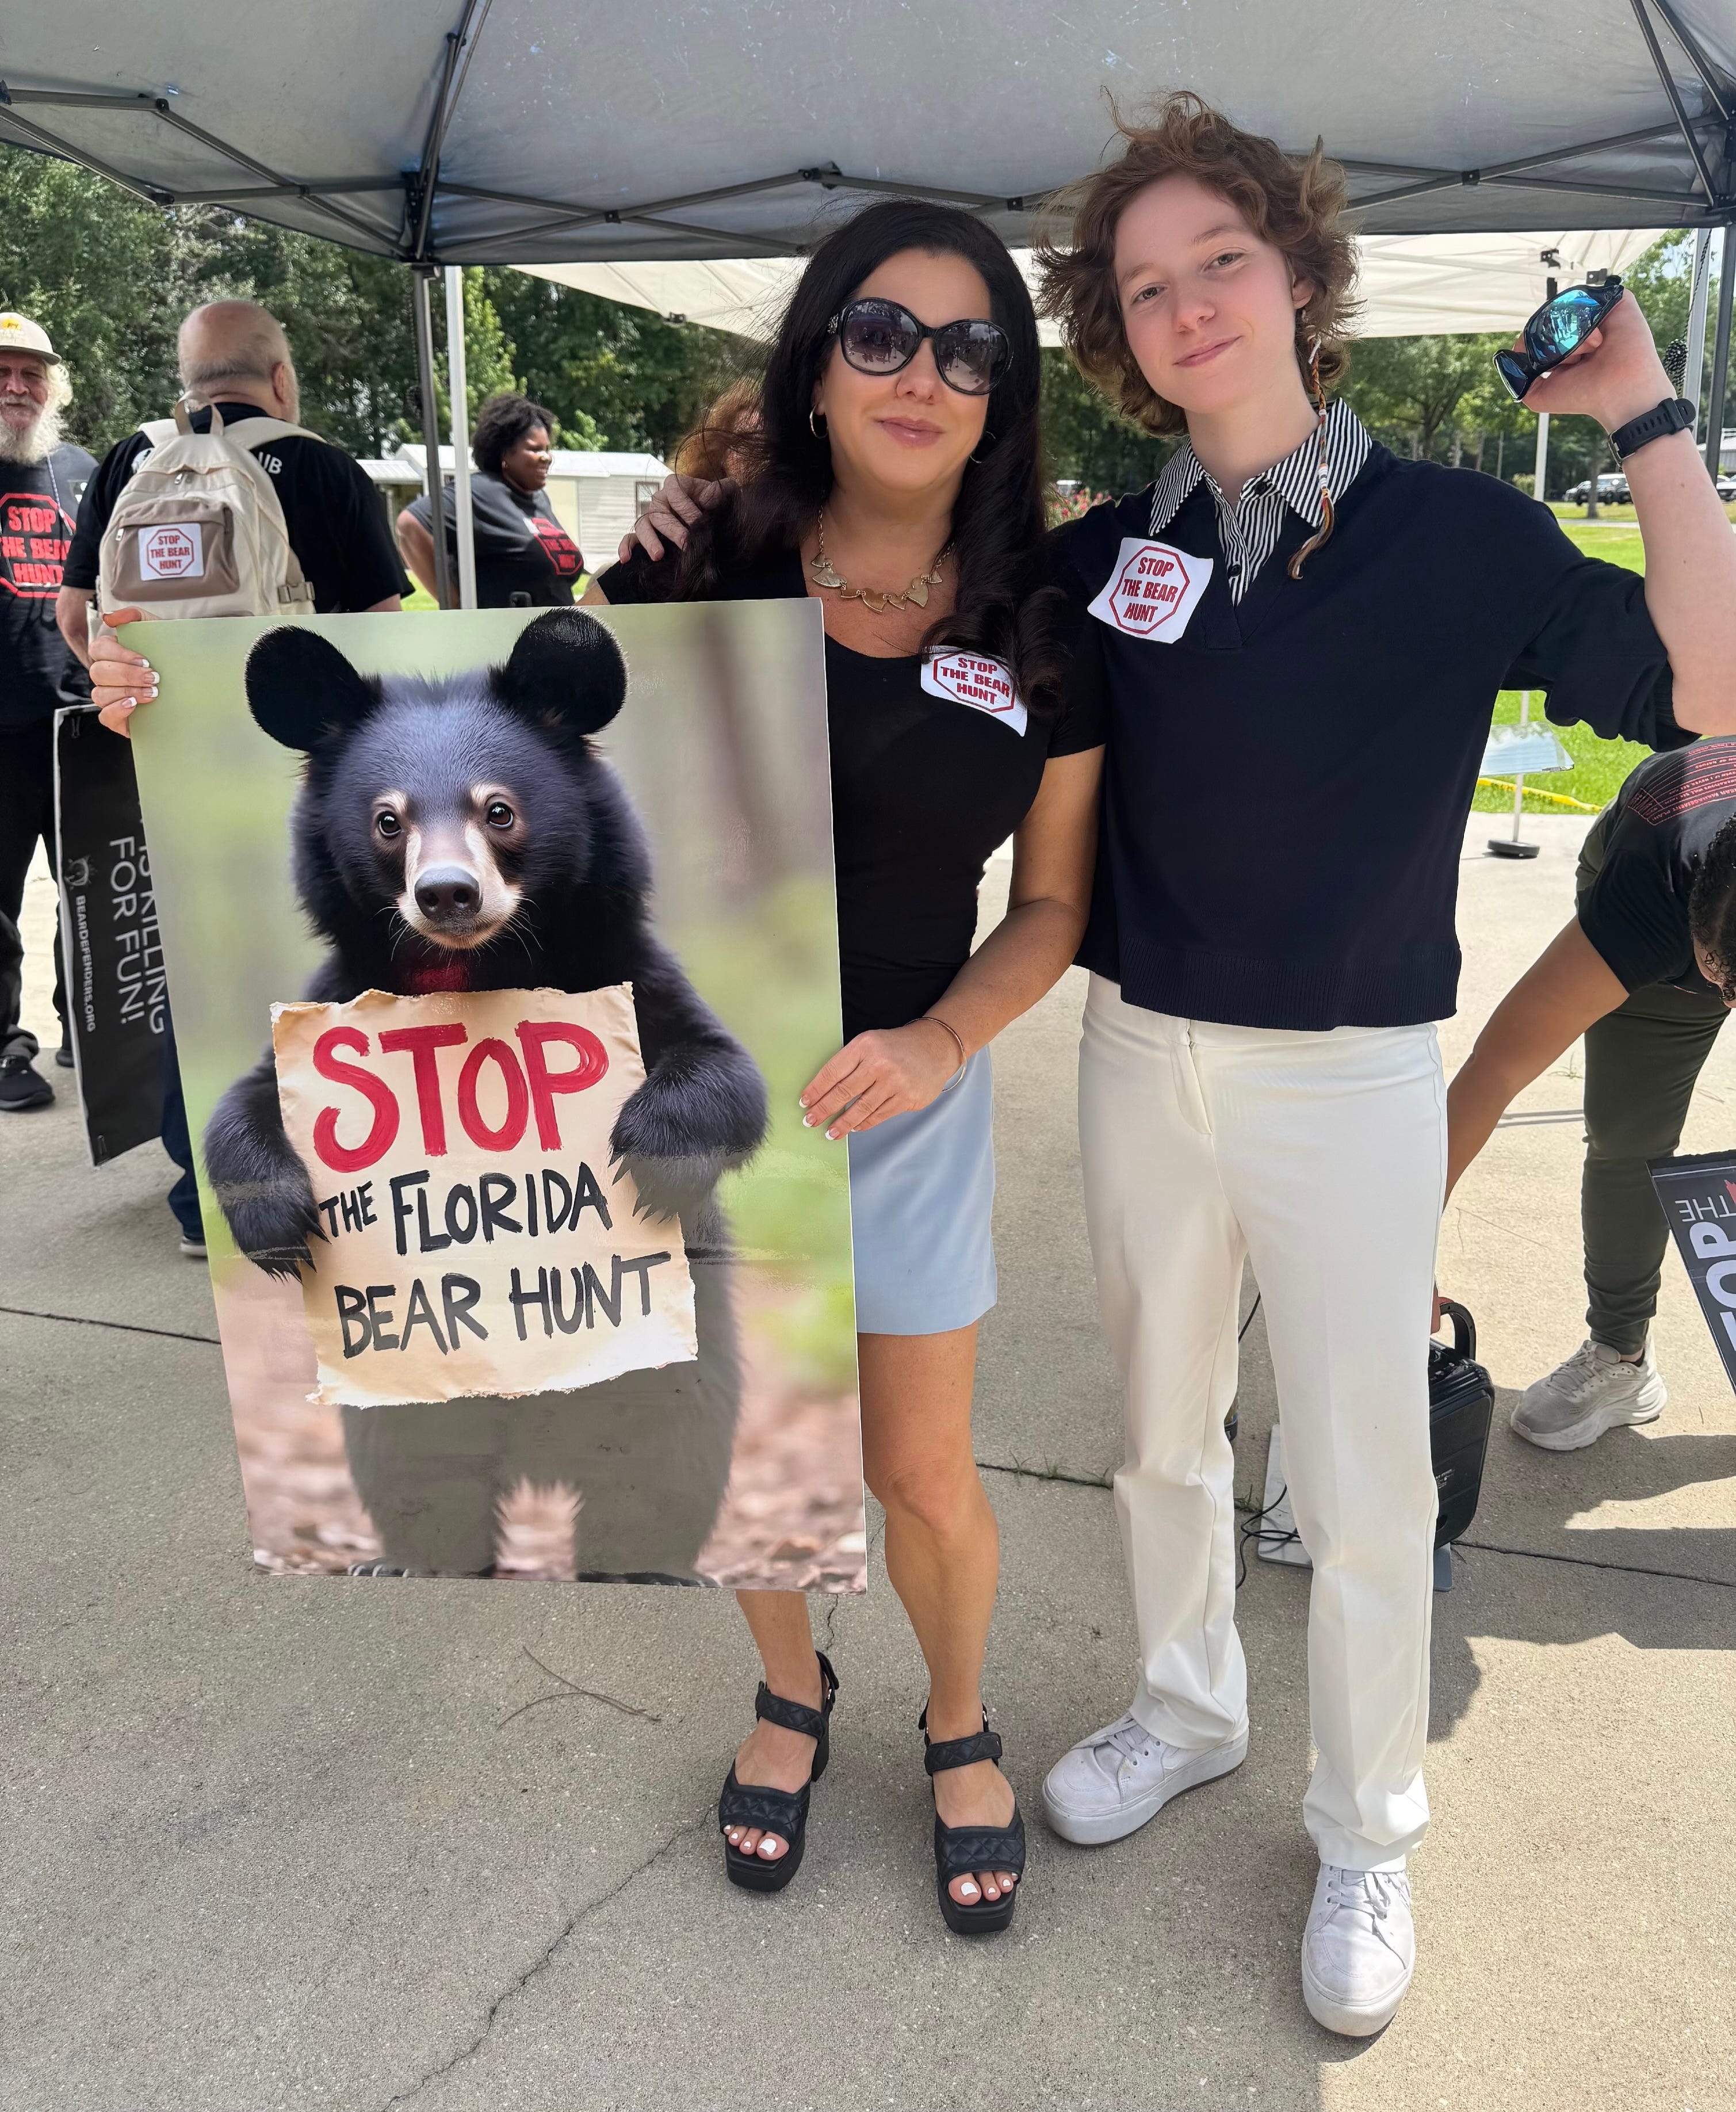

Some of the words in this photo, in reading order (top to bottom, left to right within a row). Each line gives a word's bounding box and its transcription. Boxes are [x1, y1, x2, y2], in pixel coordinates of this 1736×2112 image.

[7, 506, 56, 533] STOP
[0, 536, 27, 558] HE
[158, 534, 181, 545] STOP
[150, 548, 165, 559] THE
[167, 547, 190, 557] BEAR
[159, 559, 182, 570] HUNT
[13, 563, 64, 585] HUNT
[1137, 556, 1175, 578] STOP
[1121, 578, 1142, 597] THE
[1142, 581, 1179, 603] BEAR
[1123, 602, 1158, 622] HUNT
[958, 657, 997, 674] STOP
[940, 666, 969, 681] THE
[974, 673, 1011, 698] BEAR
[957, 682, 997, 705] HUNT
[109, 836, 137, 921] FOR
[75, 895, 95, 1033] BEARDEFENDERS.ORG
[116, 930, 145, 1025] FUN!
[313, 1019, 609, 1173] STOP
[319, 1181, 378, 1238] THE
[389, 1162, 614, 1256] FLORIDA
[1675, 1194, 1736, 1222] THE
[334, 1272, 489, 1359] BEAR
[508, 1251, 671, 1341] HUNT
